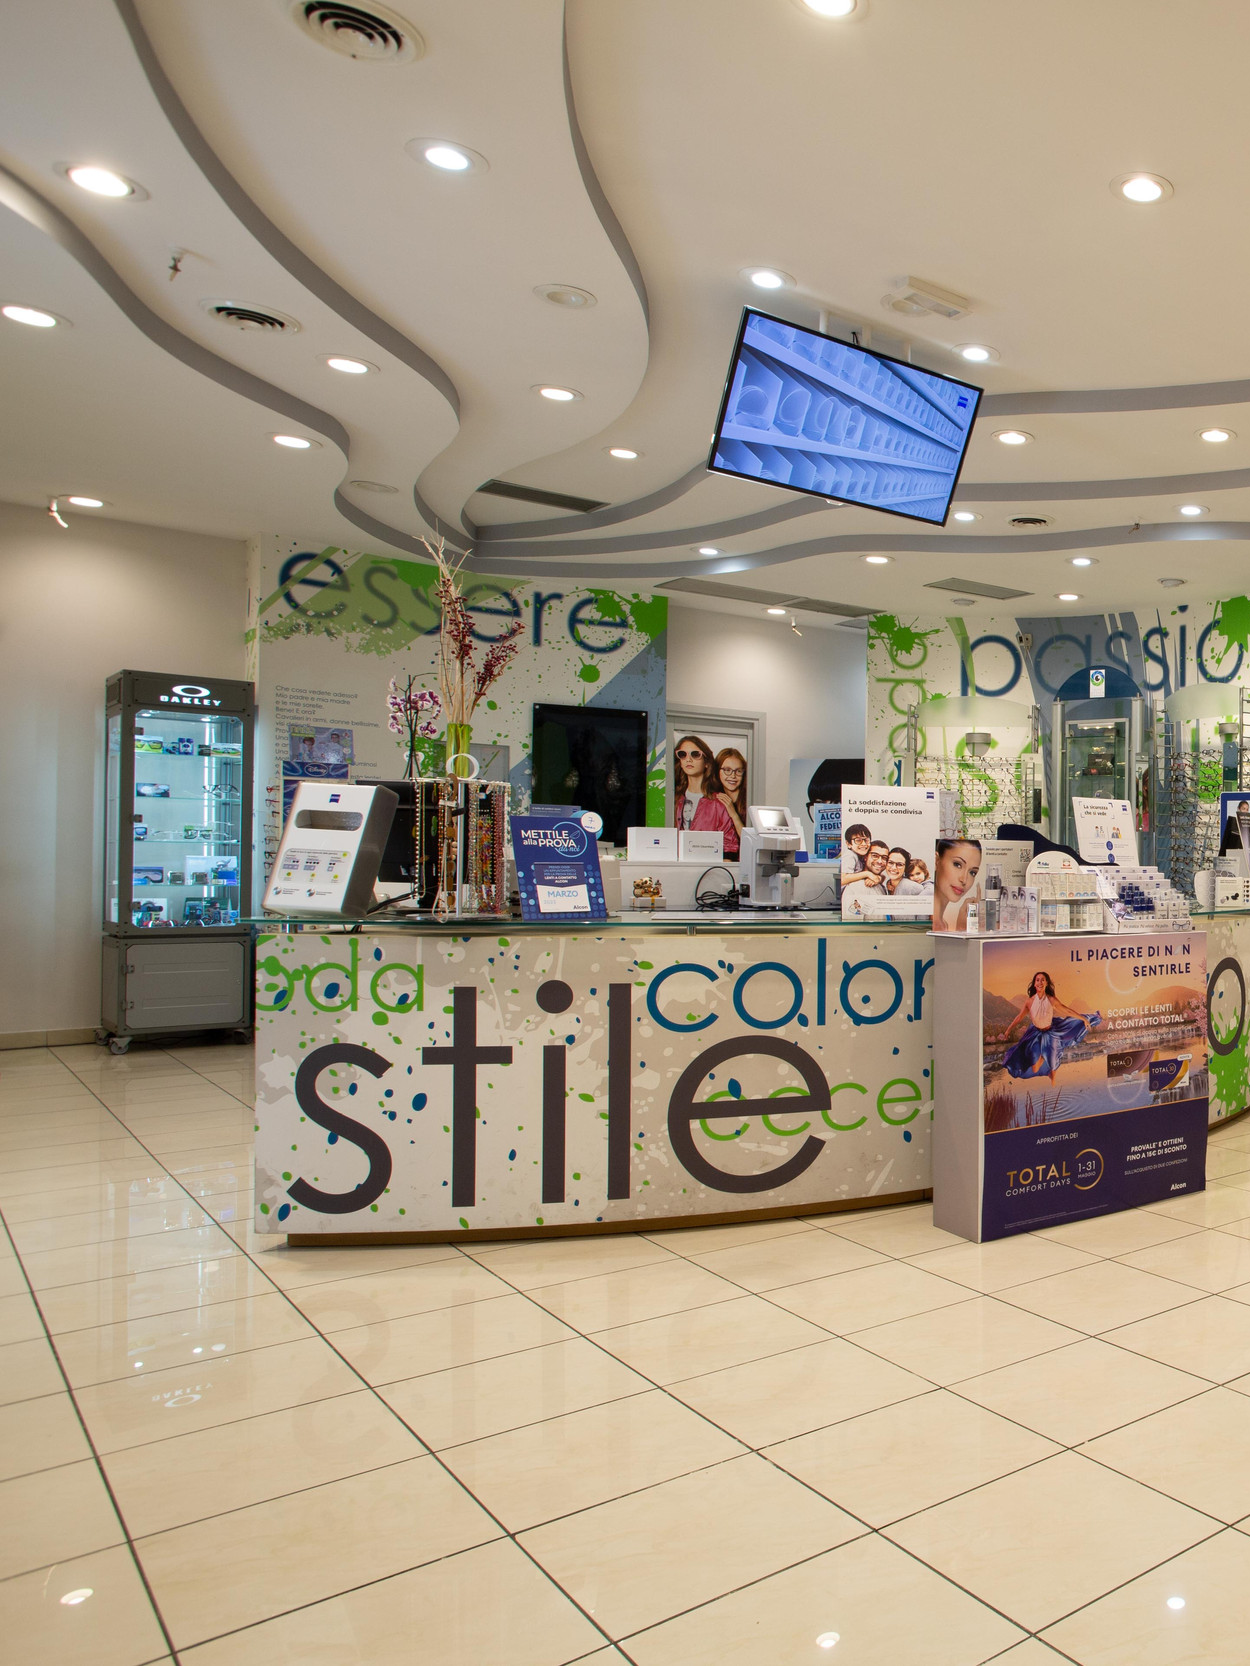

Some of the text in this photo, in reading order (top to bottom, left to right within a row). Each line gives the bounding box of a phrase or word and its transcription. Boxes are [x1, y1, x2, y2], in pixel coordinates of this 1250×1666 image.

[279, 552, 630, 653] essere
[160, 695, 222, 706] OAKLEY
[308, 764, 327, 774] Disney
[820, 813, 842, 821] ALCO
[521, 829, 569, 839] METTILE
[538, 838, 577, 848] PROVA
[547, 890, 578, 898] MARZO
[1070, 950, 1082, 962] IL
[1087, 947, 1143, 961] PIACERE
[1148, 946, 1160, 957] DI
[1133, 963, 1191, 977] SENTIRLE
[1107, 1004, 1173, 1018] SCOPRI LE LENTI
[1107, 1022, 1114, 1030] A
[1115, 1018, 1159, 1029] CONTATTO
[286, 980, 832, 1214] stile
[1036, 1133, 1069, 1145] APPROFITTA
[1163, 1137, 1184, 1146] OTTIENI
[1126, 1154, 1141, 1162] FINO
[1164, 1144, 1187, 1154] SCONTO
[1007, 1160, 1096, 1187] TOTAL 1-31
[1077, 1171, 1096, 1179] MAGGIO
[1005, 1178, 1071, 1197] COMFORT DAYS
[1170, 1182, 1186, 1190] Alcon
